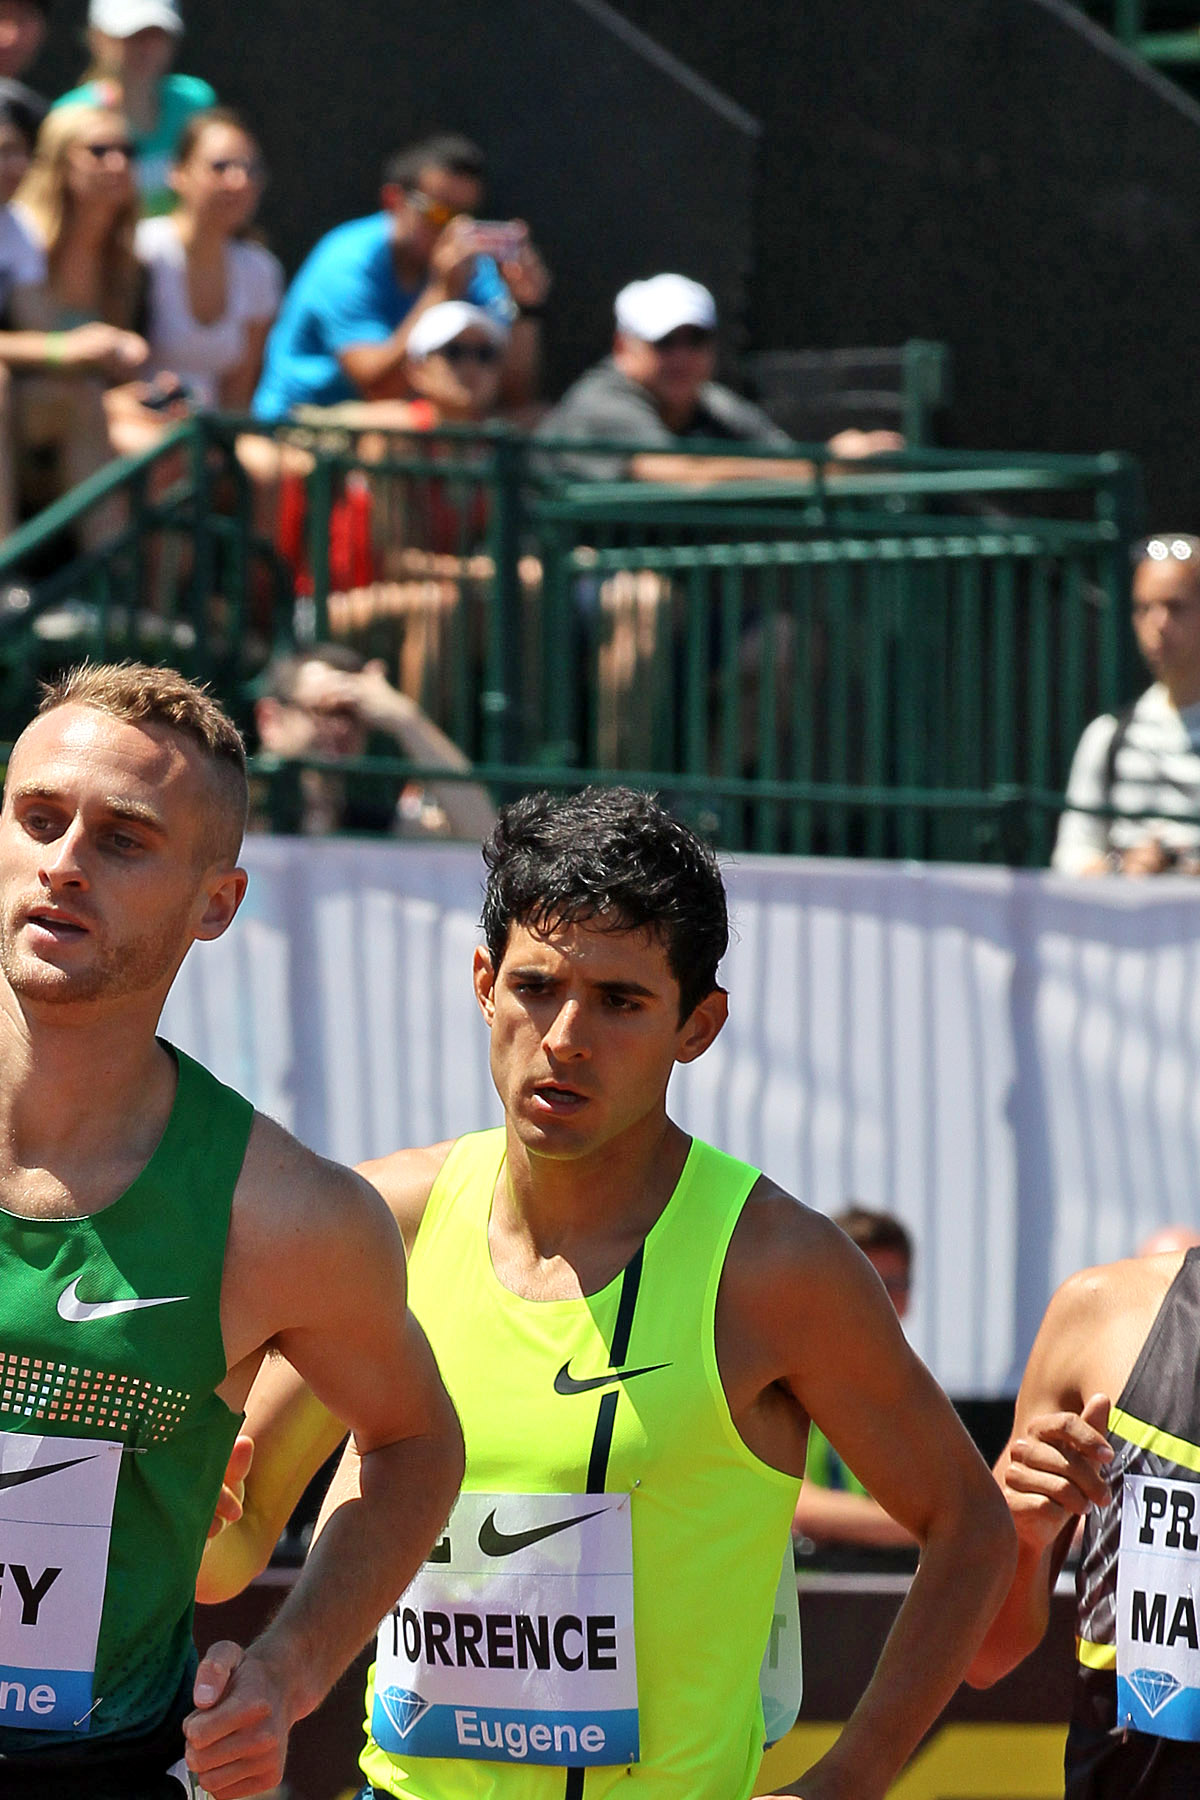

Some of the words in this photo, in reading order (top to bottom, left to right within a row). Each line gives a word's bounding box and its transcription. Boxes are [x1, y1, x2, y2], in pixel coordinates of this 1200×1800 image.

[1139, 1485, 1200, 1549] PR
[392, 1607, 618, 1672] TORRENCE
[454, 1709, 606, 1757] Eugene
